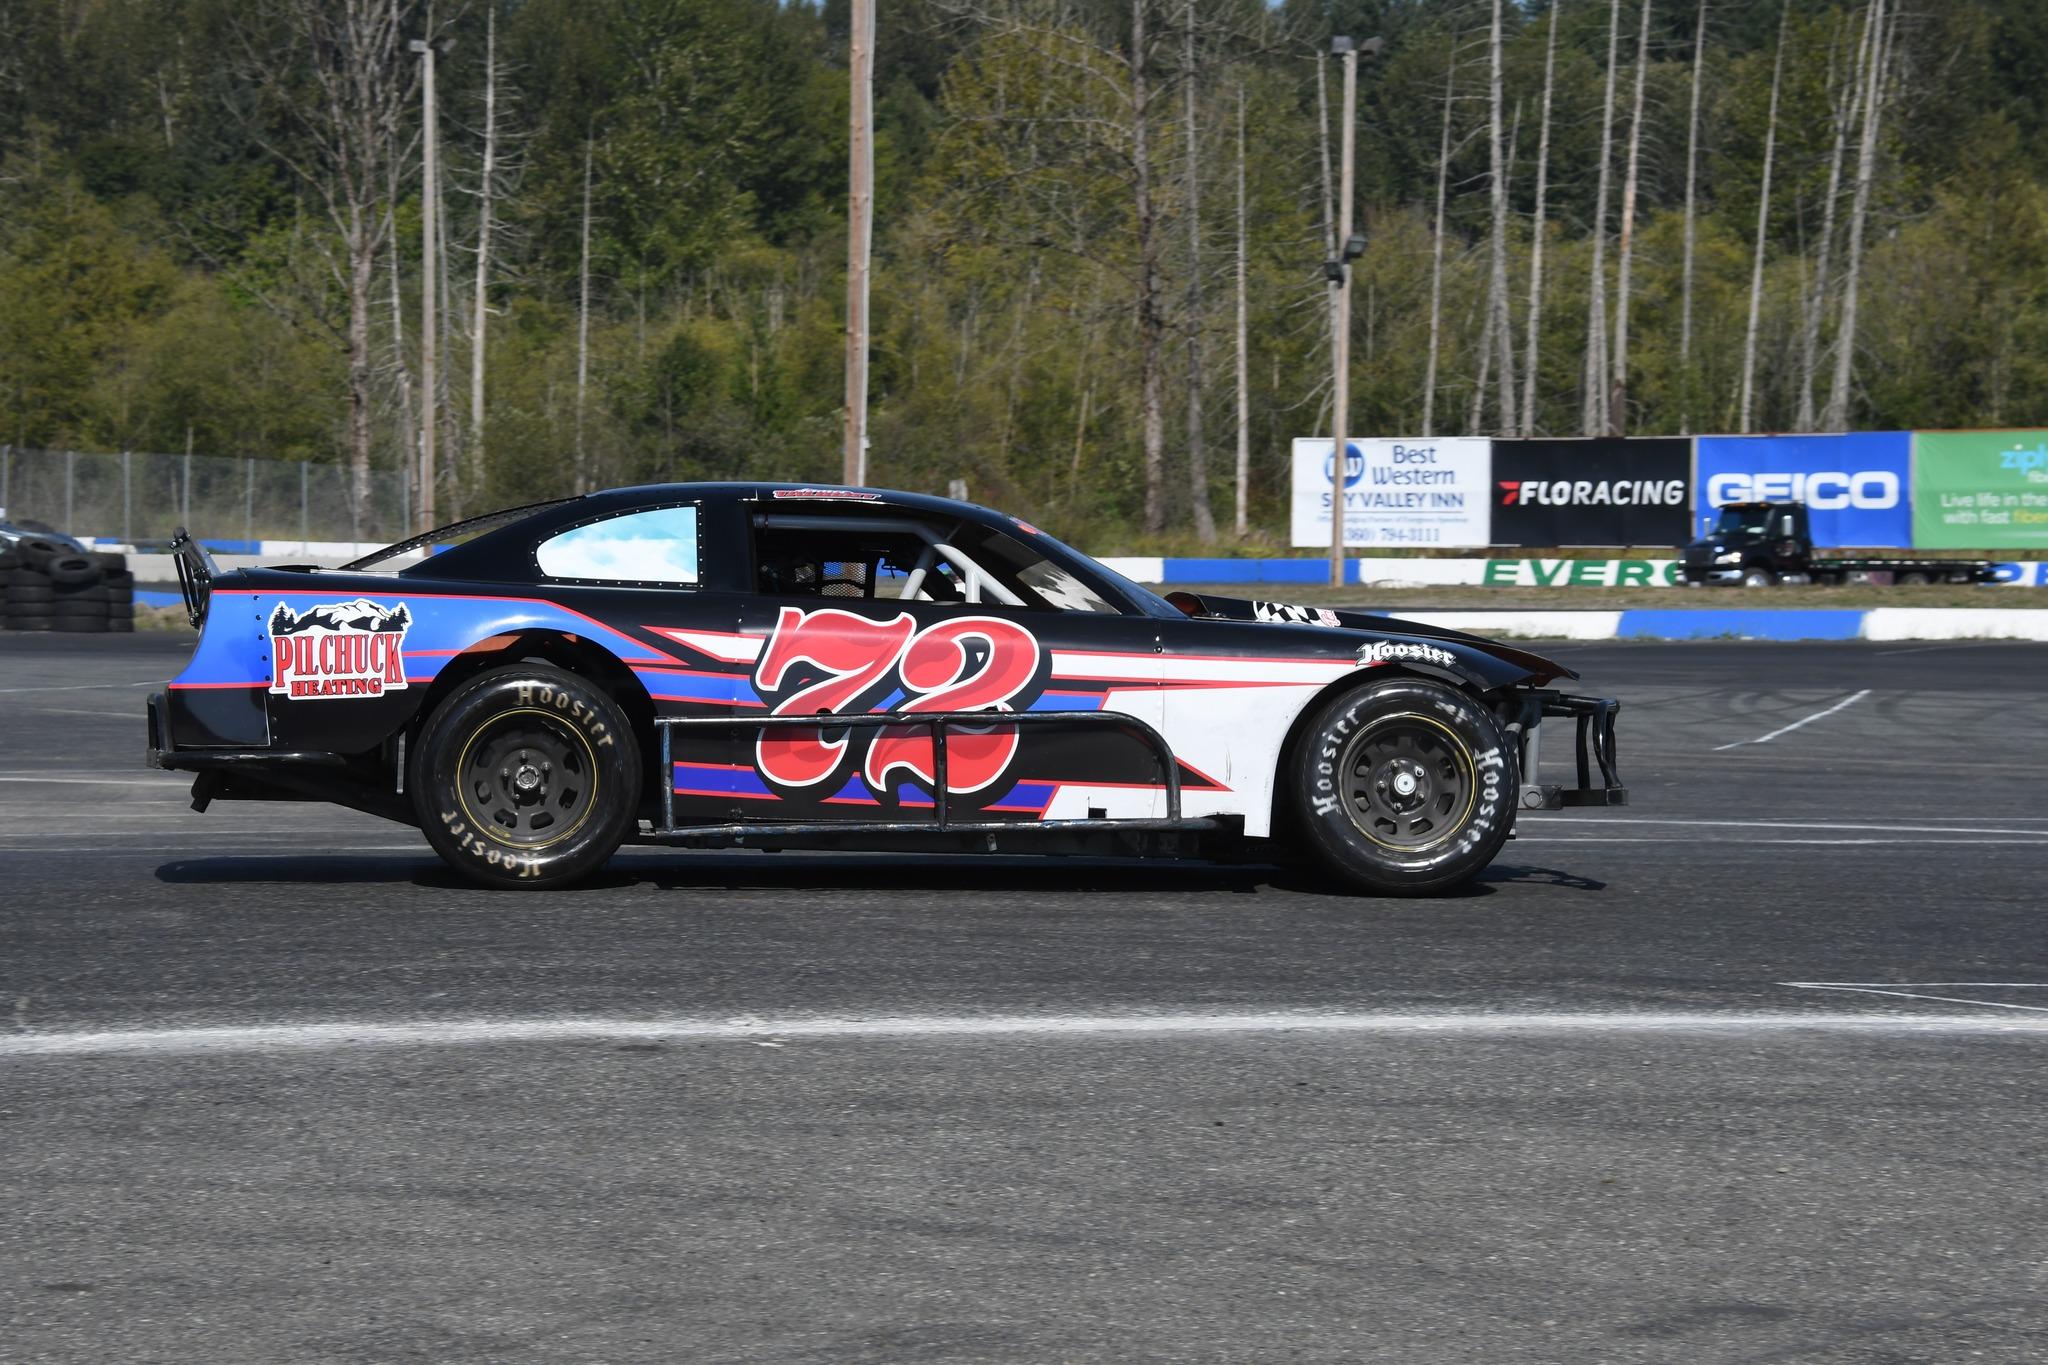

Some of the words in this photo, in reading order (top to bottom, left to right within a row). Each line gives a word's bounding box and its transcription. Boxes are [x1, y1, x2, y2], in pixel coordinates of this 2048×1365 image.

[1393, 445, 1437, 464] Best
[2000, 443, 2048, 476] zipl
[1372, 466, 1456, 485] Western
[1321, 492, 1357, 508] SY
[1359, 492, 1429, 508] VALLEY
[1431, 493, 1465, 508] INN
[1519, 480, 1684, 506] FLORACING
[1707, 471, 1899, 510] GEICO
[1941, 493, 1975, 508] Live
[274, 634, 404, 688] PILCHUCK
[1356, 640, 1455, 667] Hoosier
[291, 678, 383, 697] HEATING
[755, 606, 1041, 795] 72
[513, 685, 614, 747] Hoosier
[1312, 708, 1359, 817] Hoosier
